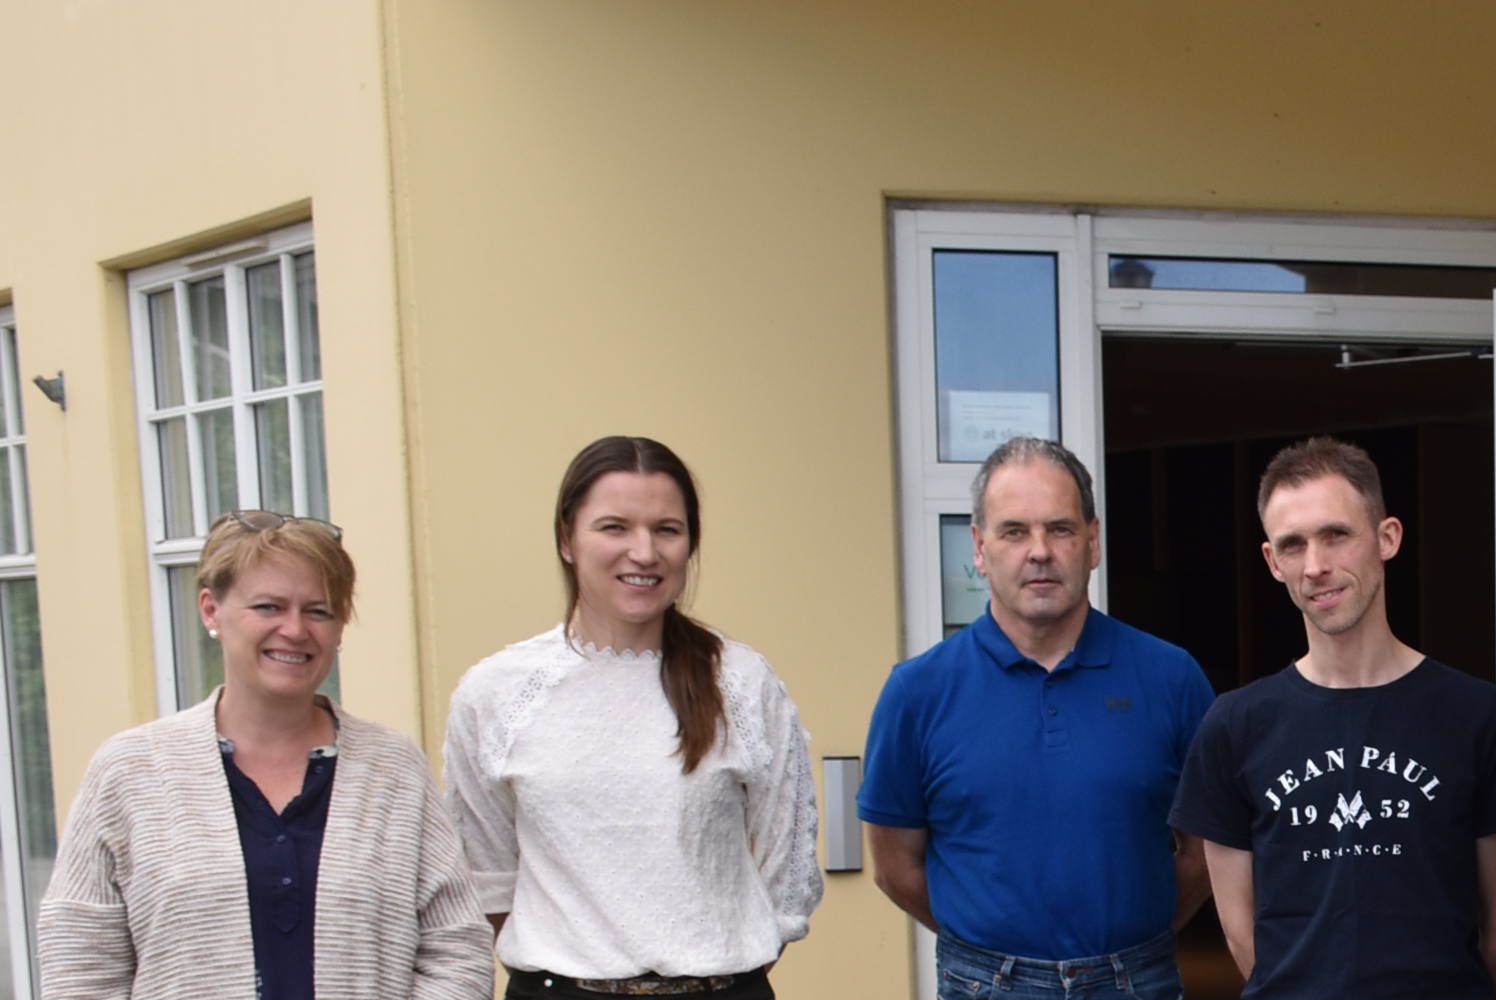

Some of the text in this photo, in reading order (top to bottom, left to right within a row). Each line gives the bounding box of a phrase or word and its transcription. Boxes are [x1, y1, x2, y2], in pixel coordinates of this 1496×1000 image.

[1265, 745, 1441, 812] JEAN PAUL
[1289, 799, 1410, 826] 19 52
